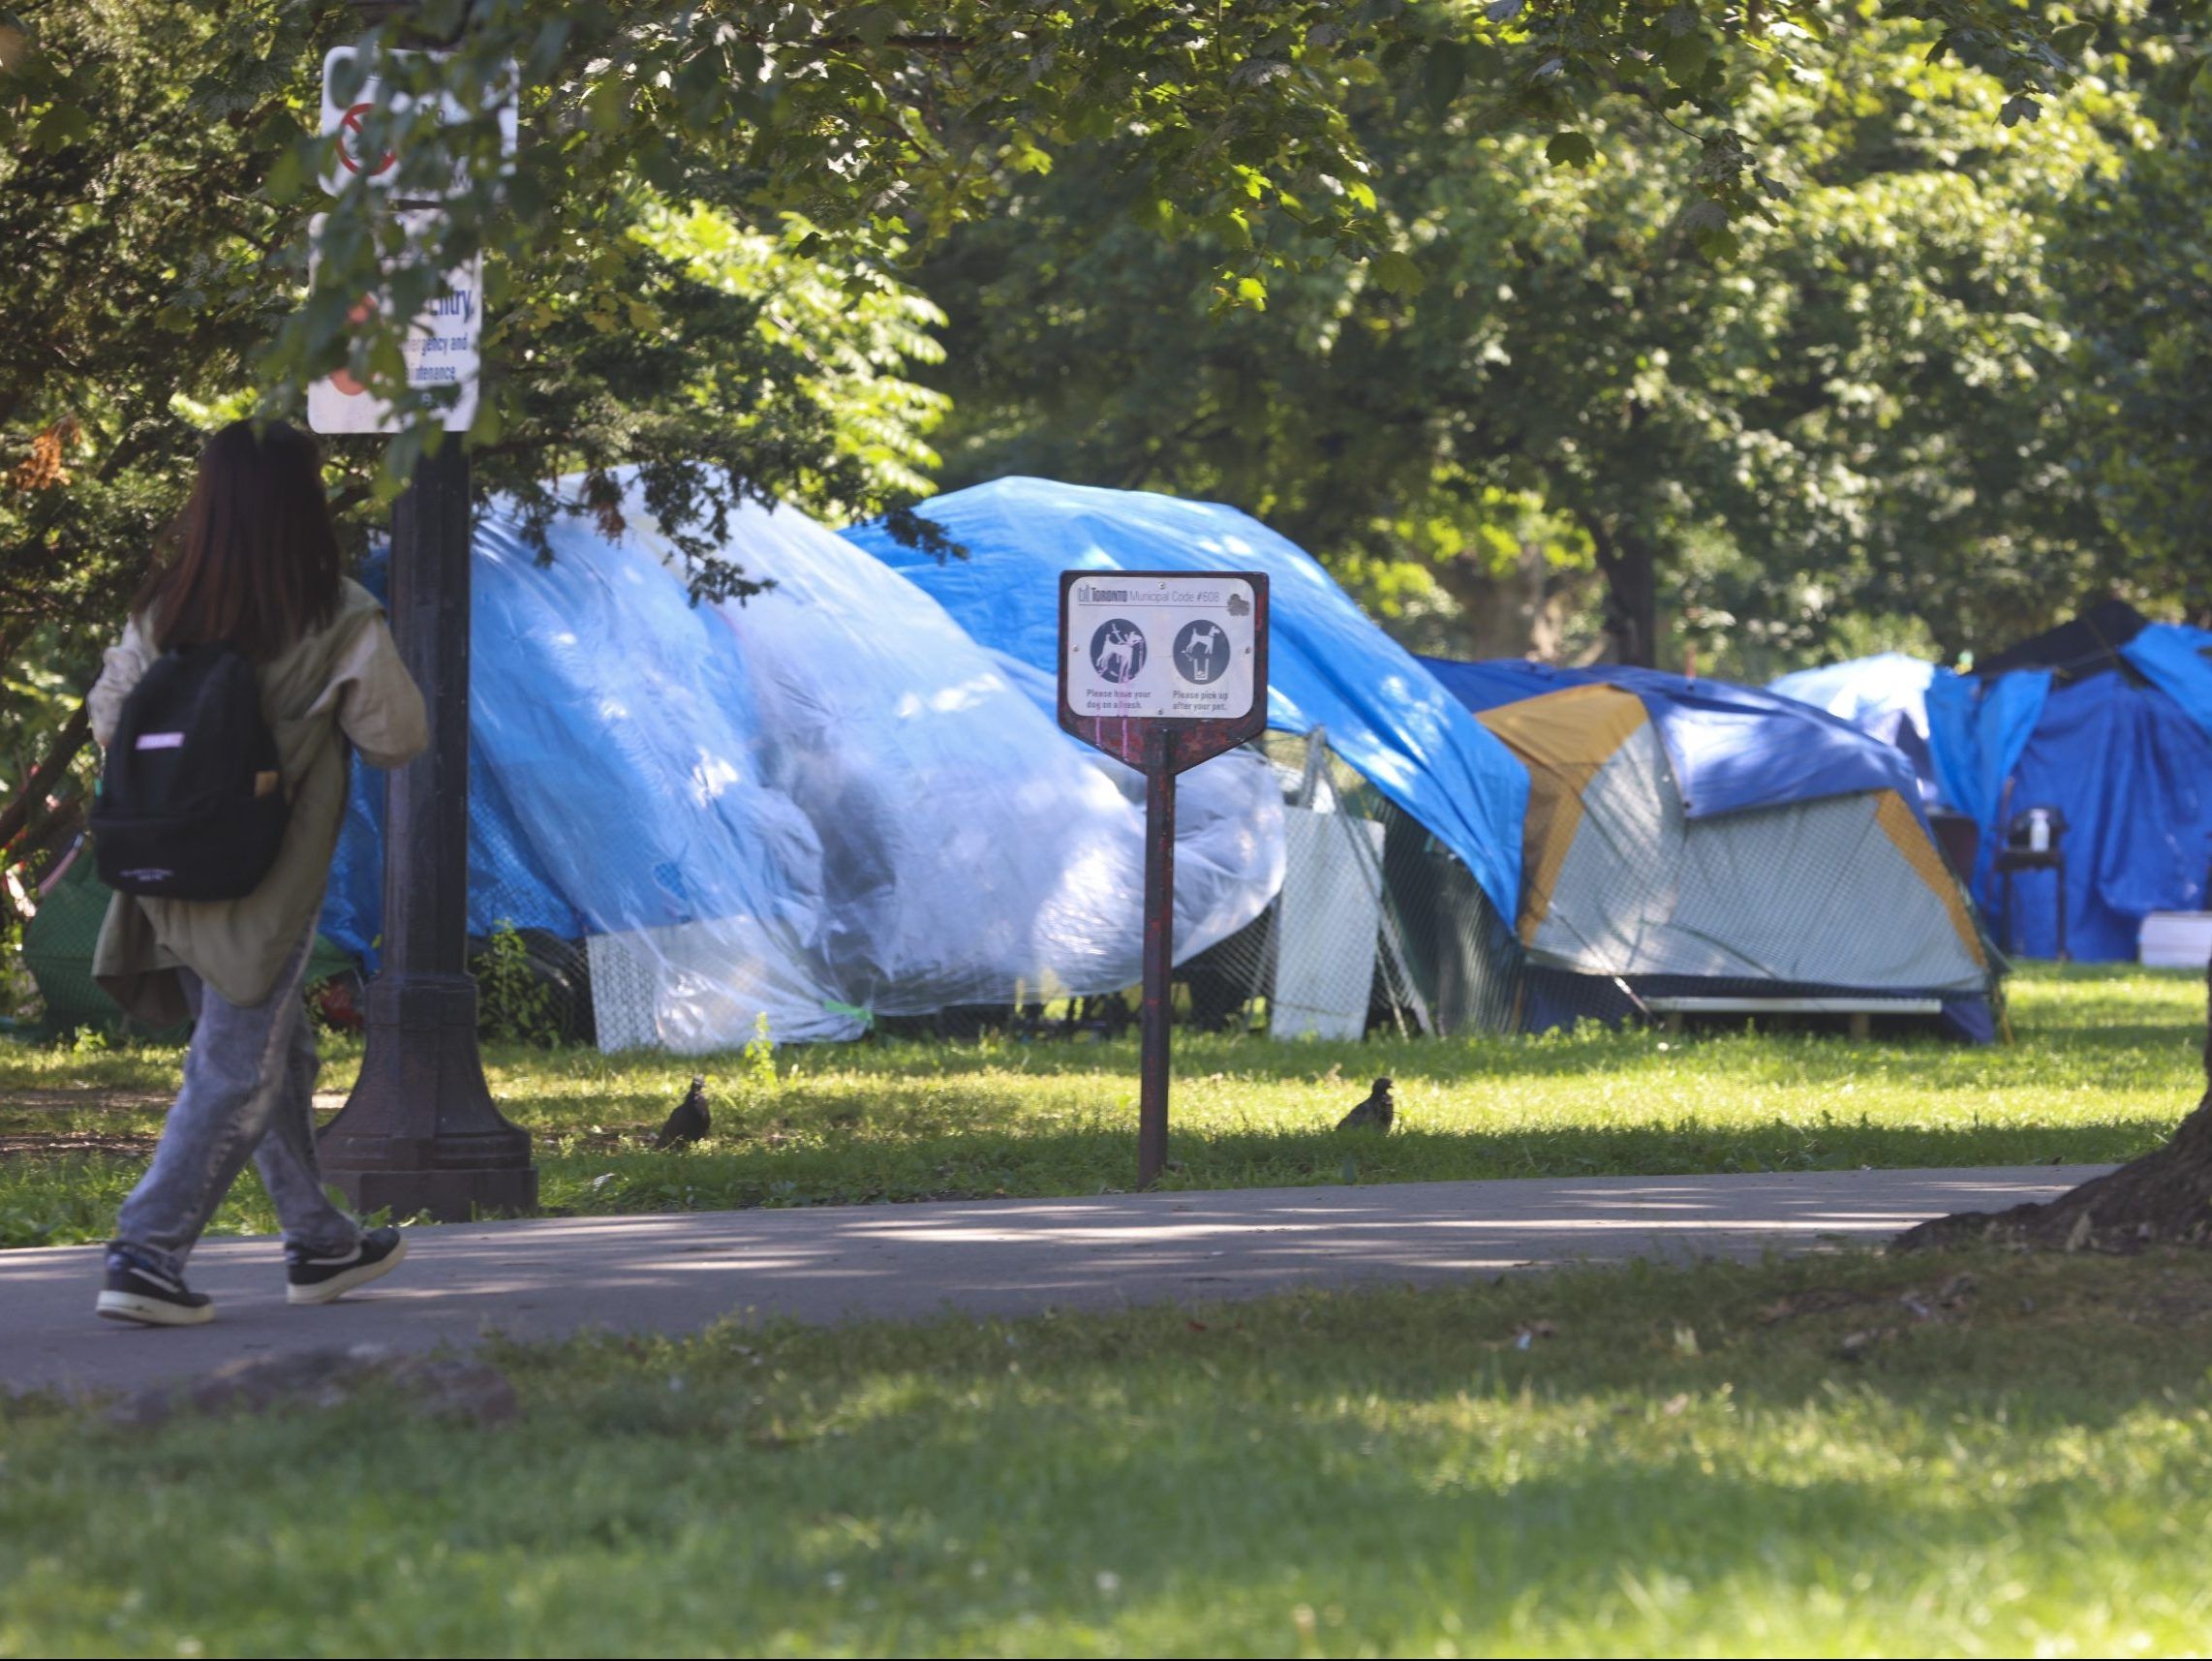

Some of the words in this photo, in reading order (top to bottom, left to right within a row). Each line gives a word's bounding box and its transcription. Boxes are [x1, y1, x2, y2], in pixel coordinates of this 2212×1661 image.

[450, 332, 469, 351] and
[1129, 590, 1169, 603] Municipal
[1172, 591, 1194, 602] Code
[1086, 689, 1113, 698] Please
[1172, 690, 1199, 699] Please
[1200, 690, 1216, 701] pick
[1218, 692, 1229, 701] up
[1087, 700, 1101, 709] dog
[1172, 700, 1192, 710] after
[1193, 703, 1212, 712] your
